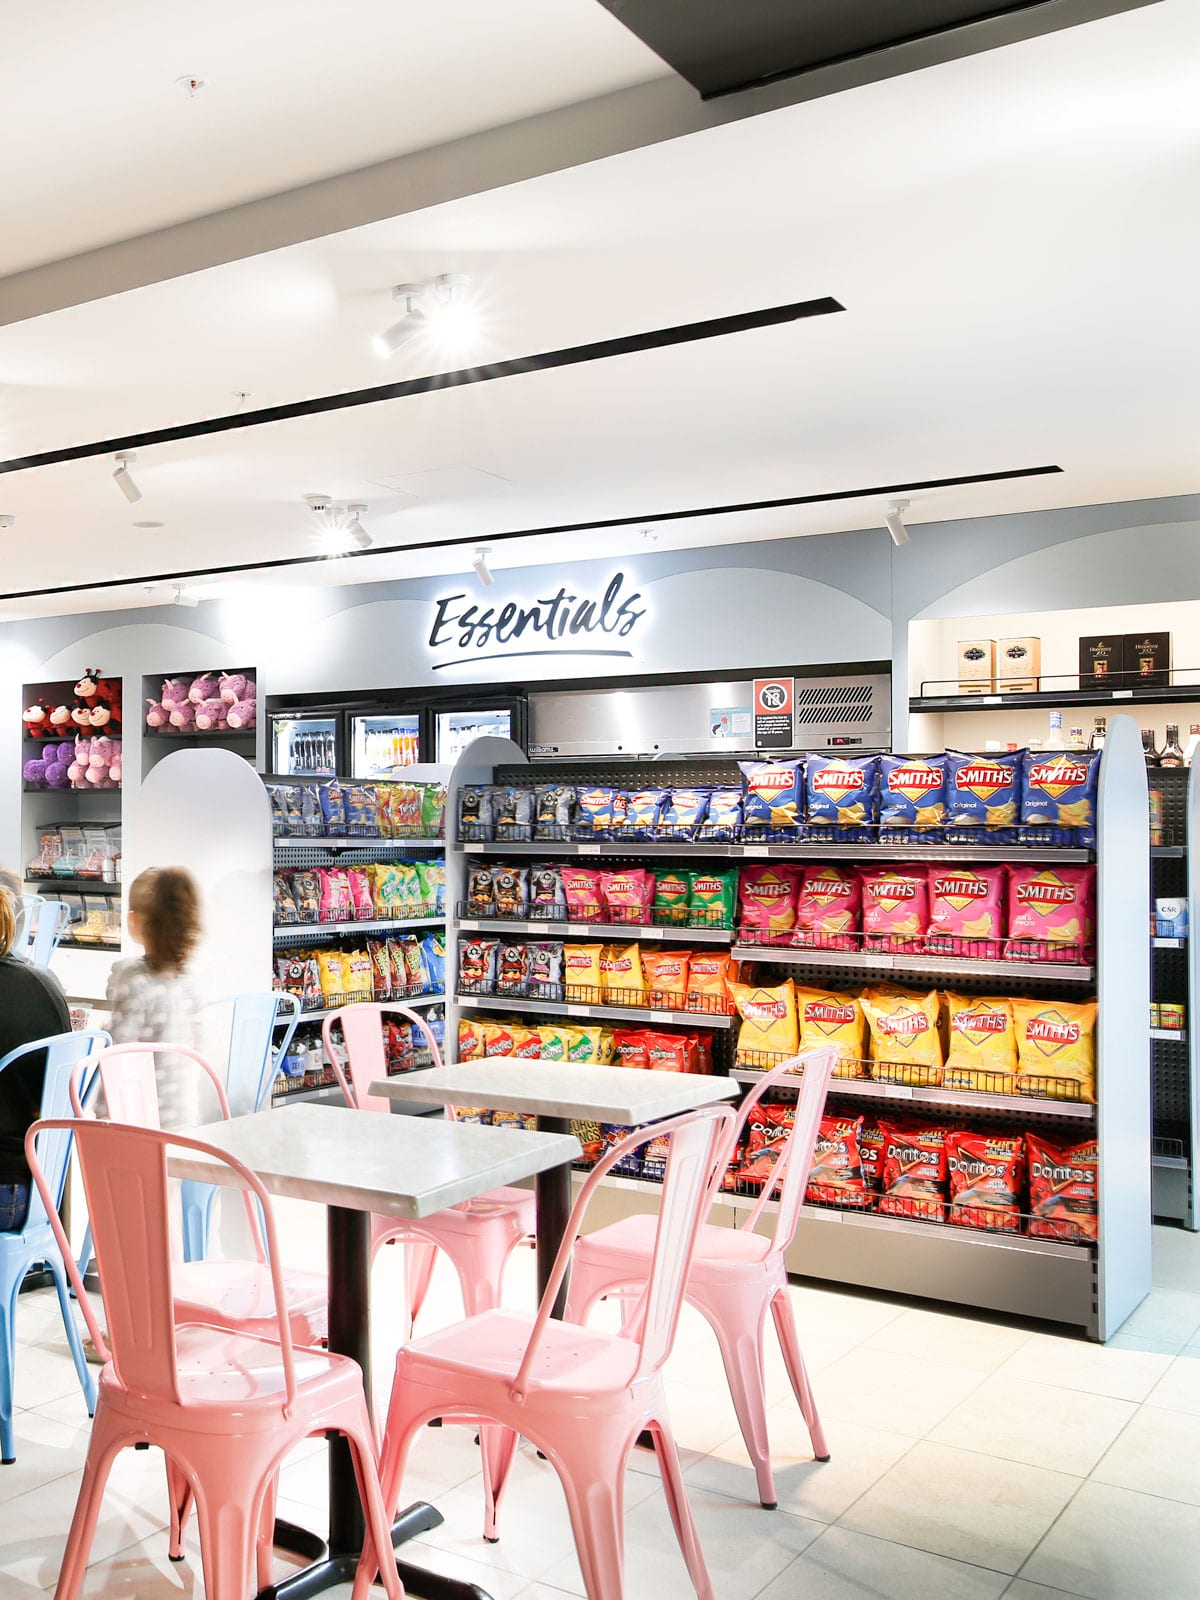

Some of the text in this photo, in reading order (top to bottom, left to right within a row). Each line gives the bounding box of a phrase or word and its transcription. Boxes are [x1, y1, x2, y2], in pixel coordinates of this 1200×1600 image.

[429, 573, 647, 647] Essentials
[813, 771, 864, 787] SMITH'S
[888, 769, 942, 786] SMITH'S
[957, 769, 1013, 785] SMITH'S
[953, 802, 977, 810] Original
[1025, 800, 1048, 808] Original
[693, 881, 722, 891] SMITH'S
[745, 881, 792, 896] SMITH'S
[804, 880, 852, 895] SMITH'S
[933, 879, 988, 895] SMITH'S
[1017, 884, 1075, 900] SMITH'S
[1026, 1021, 1080, 1040] SMITH'S
[751, 1122, 792, 1138] Dorito
[887, 1145, 939, 1164] Doritos
[948, 1157, 1007, 1178] Doritos
[1031, 1163, 1095, 1183] Doritos
